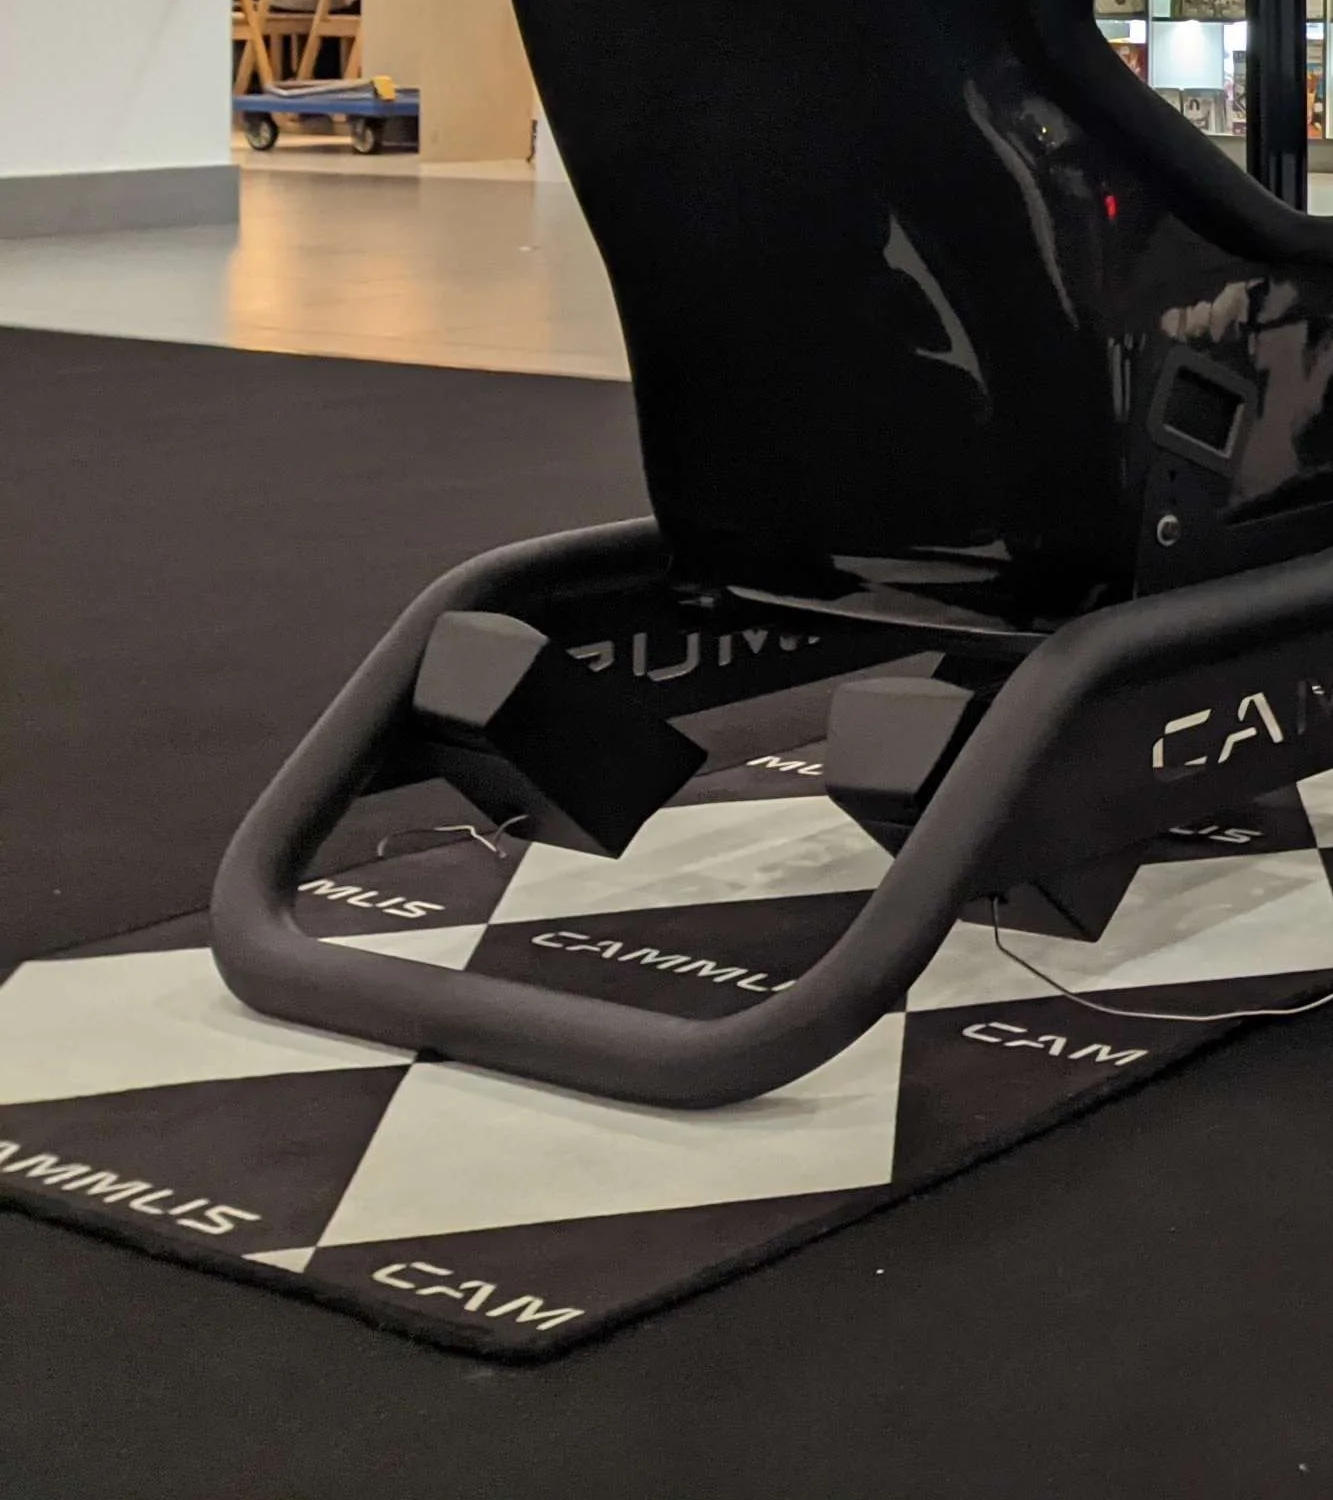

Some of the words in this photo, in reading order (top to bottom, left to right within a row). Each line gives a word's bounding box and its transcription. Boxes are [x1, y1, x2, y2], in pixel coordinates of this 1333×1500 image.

[745, 755, 824, 776] MU
[530, 931, 798, 993] CAMMU
[962, 1021, 1150, 1068] CAM
[0, 1140, 262, 1235] AMMUS
[369, 1258, 586, 1332] CAM
